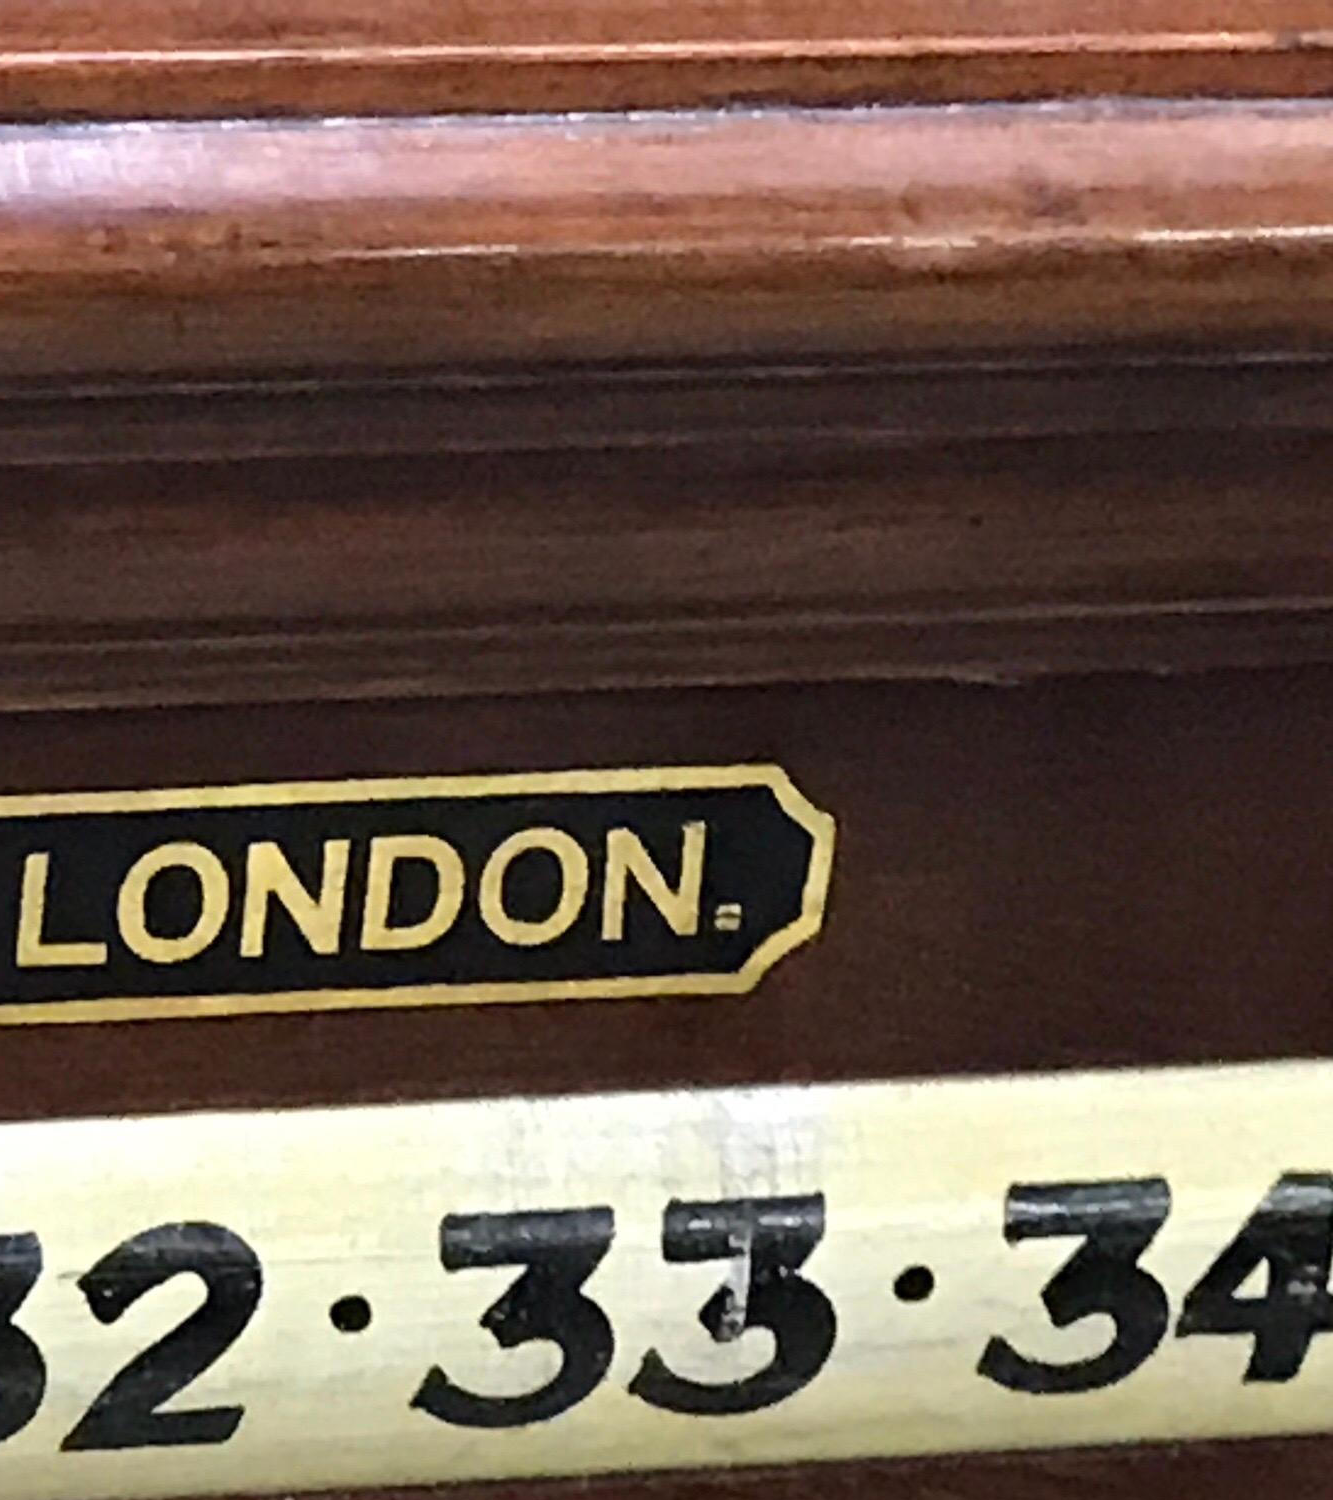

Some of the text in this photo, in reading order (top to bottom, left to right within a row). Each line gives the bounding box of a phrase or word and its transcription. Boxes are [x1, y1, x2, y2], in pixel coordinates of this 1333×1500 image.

[15, 820, 742, 968] LONDON.
[408, 1192, 837, 1429] 33
[976, 1170, 1333, 1396] 34
